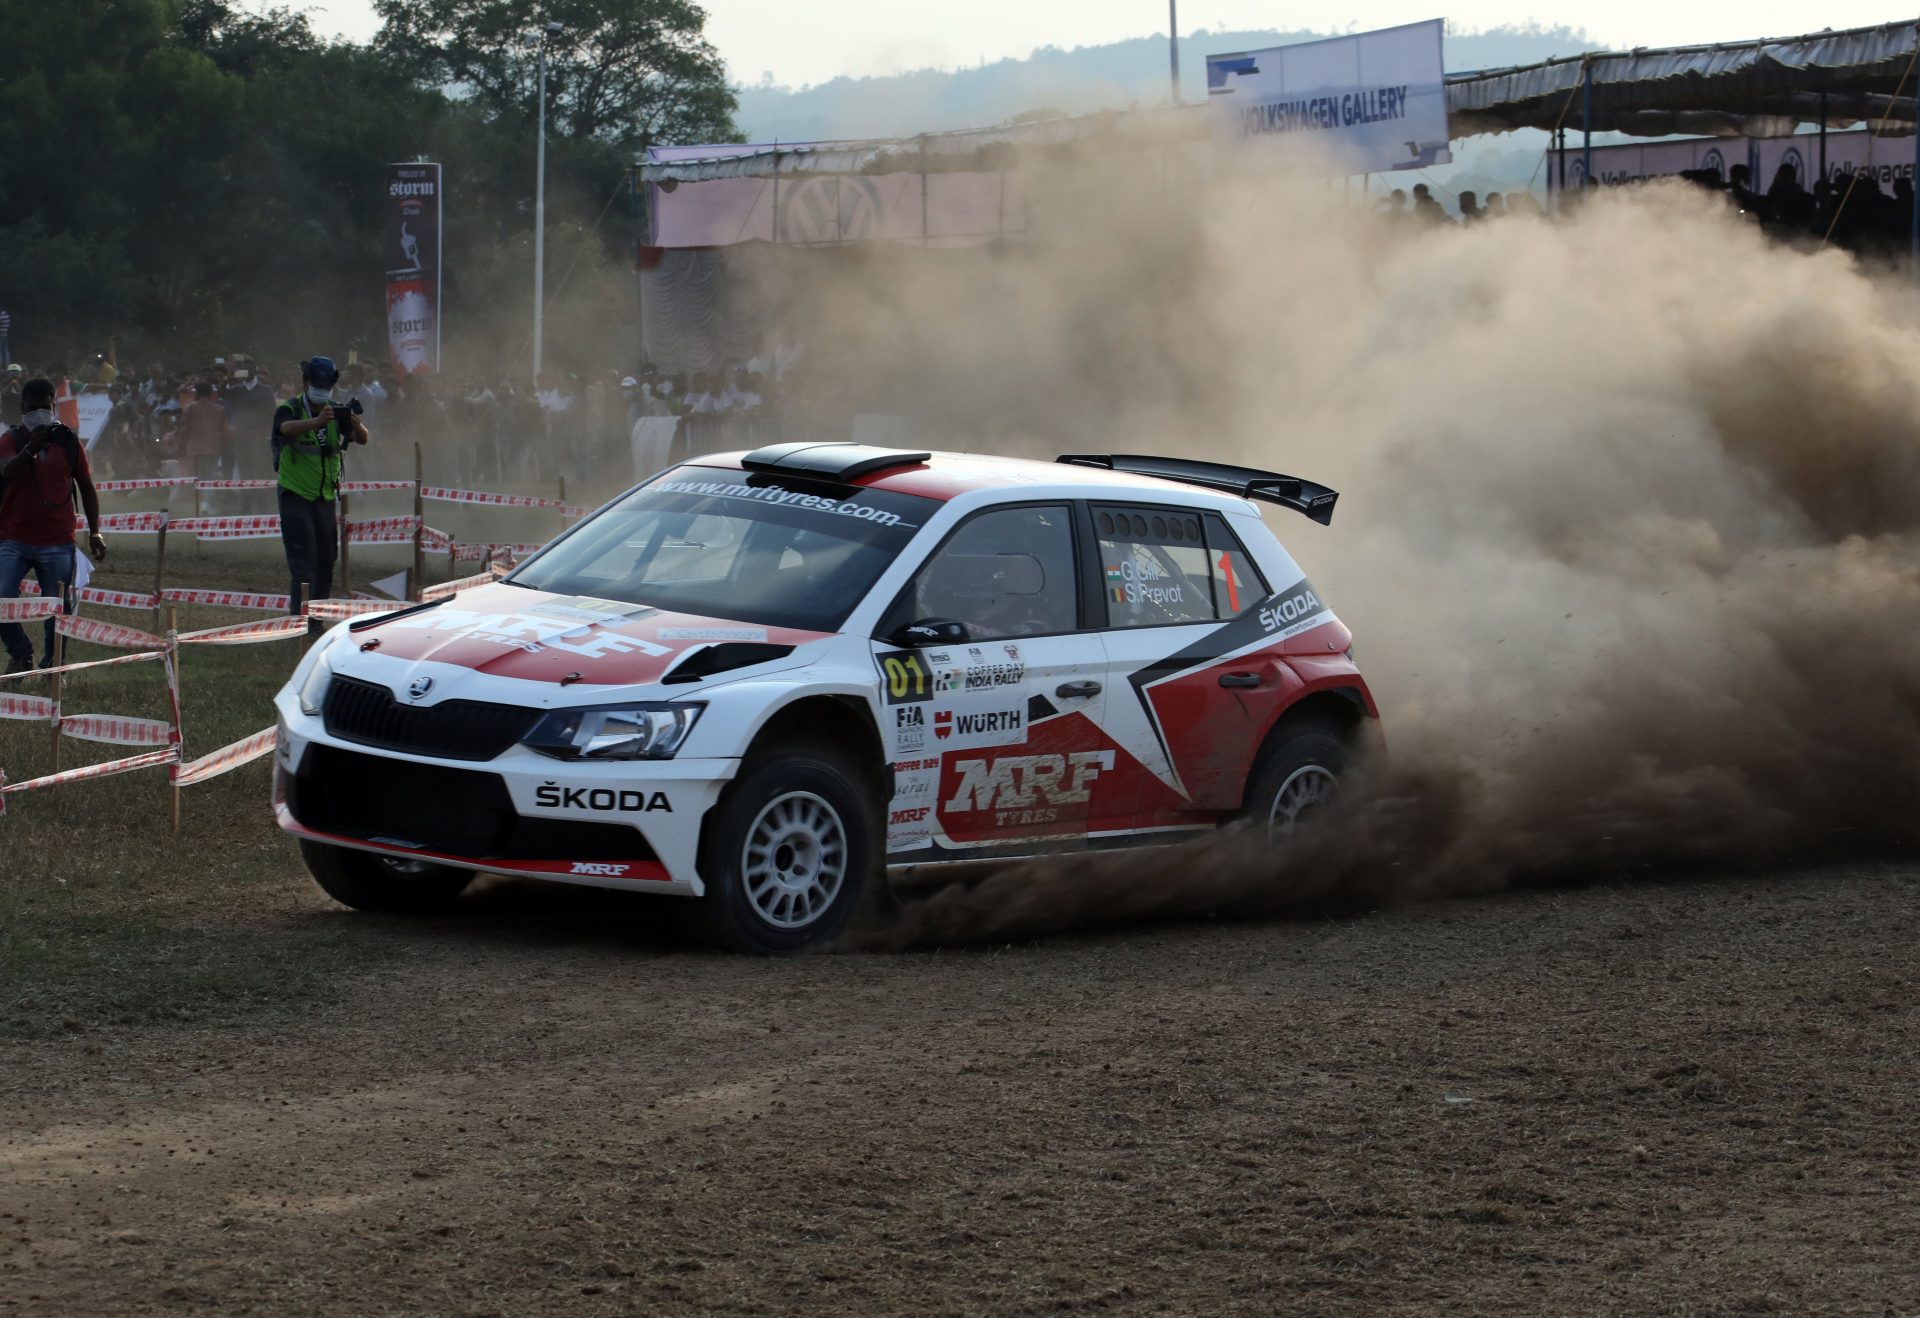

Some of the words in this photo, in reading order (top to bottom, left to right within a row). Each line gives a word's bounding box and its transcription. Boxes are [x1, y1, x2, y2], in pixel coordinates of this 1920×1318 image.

[1240, 97, 1339, 138] VOLKSWAGEN
[1342, 85, 1407, 126] GALLERY
[389, 180, 434, 196] storm
[655, 482, 901, 527] www.mrftyres.com
[1124, 583, 1184, 604] S.Prevot
[1217, 551, 1241, 612] 1
[1259, 590, 1319, 633] ŠKODA
[391, 610, 674, 659] MRF
[884, 655, 925, 698] 01
[965, 675, 992, 689] INDIA
[994, 671, 1024, 685] RALLY
[967, 664, 1004, 676] COFFEE
[1006, 662, 1025, 673] DAY
[956, 710, 1021, 735] WÜRTH
[944, 749, 1116, 813] MRF
[535, 781, 673, 813] ŠKODA
[890, 806, 931, 825] MRF
[995, 808, 1057, 827] TYRES
[569, 862, 630, 876] MRF
